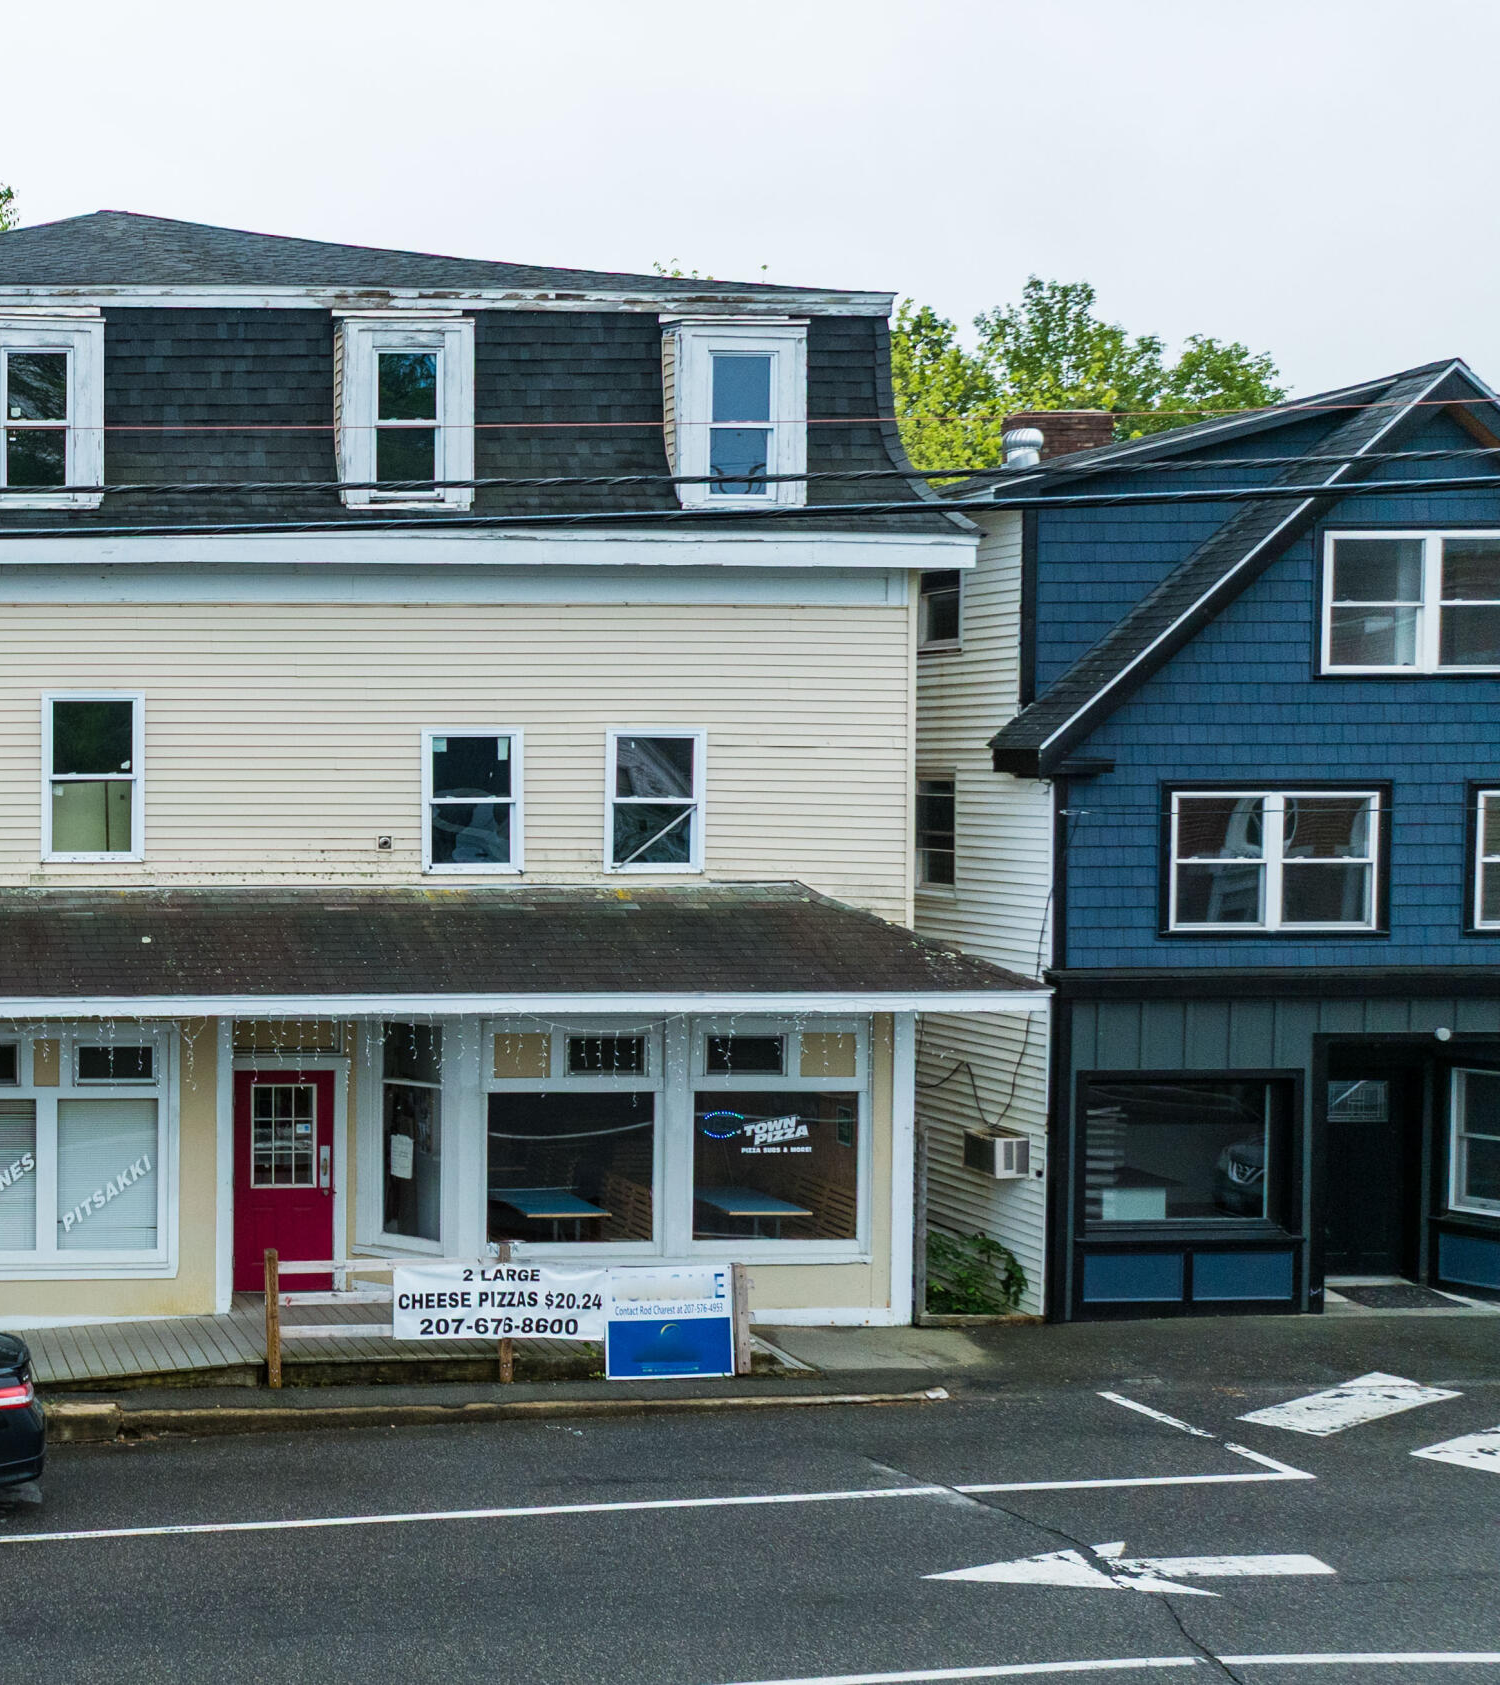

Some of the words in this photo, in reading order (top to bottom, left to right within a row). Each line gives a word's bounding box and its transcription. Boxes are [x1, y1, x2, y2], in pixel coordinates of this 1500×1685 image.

[743, 1116, 797, 1137] TOWN
[754, 1124, 809, 1146] PIZZA
[62, 1153, 152, 1233] PITSAKKI
[463, 1269, 473, 1282] 2
[481, 1269, 540, 1282] LARGE
[399, 1292, 472, 1309] CHEESE
[478, 1291, 538, 1308] PIZZAS
[545, 1291, 602, 1310] $20.24
[614, 1306, 638, 1316] Contact
[640, 1305, 652, 1315] Rod
[420, 1317, 578, 1335] 207-676-8600
